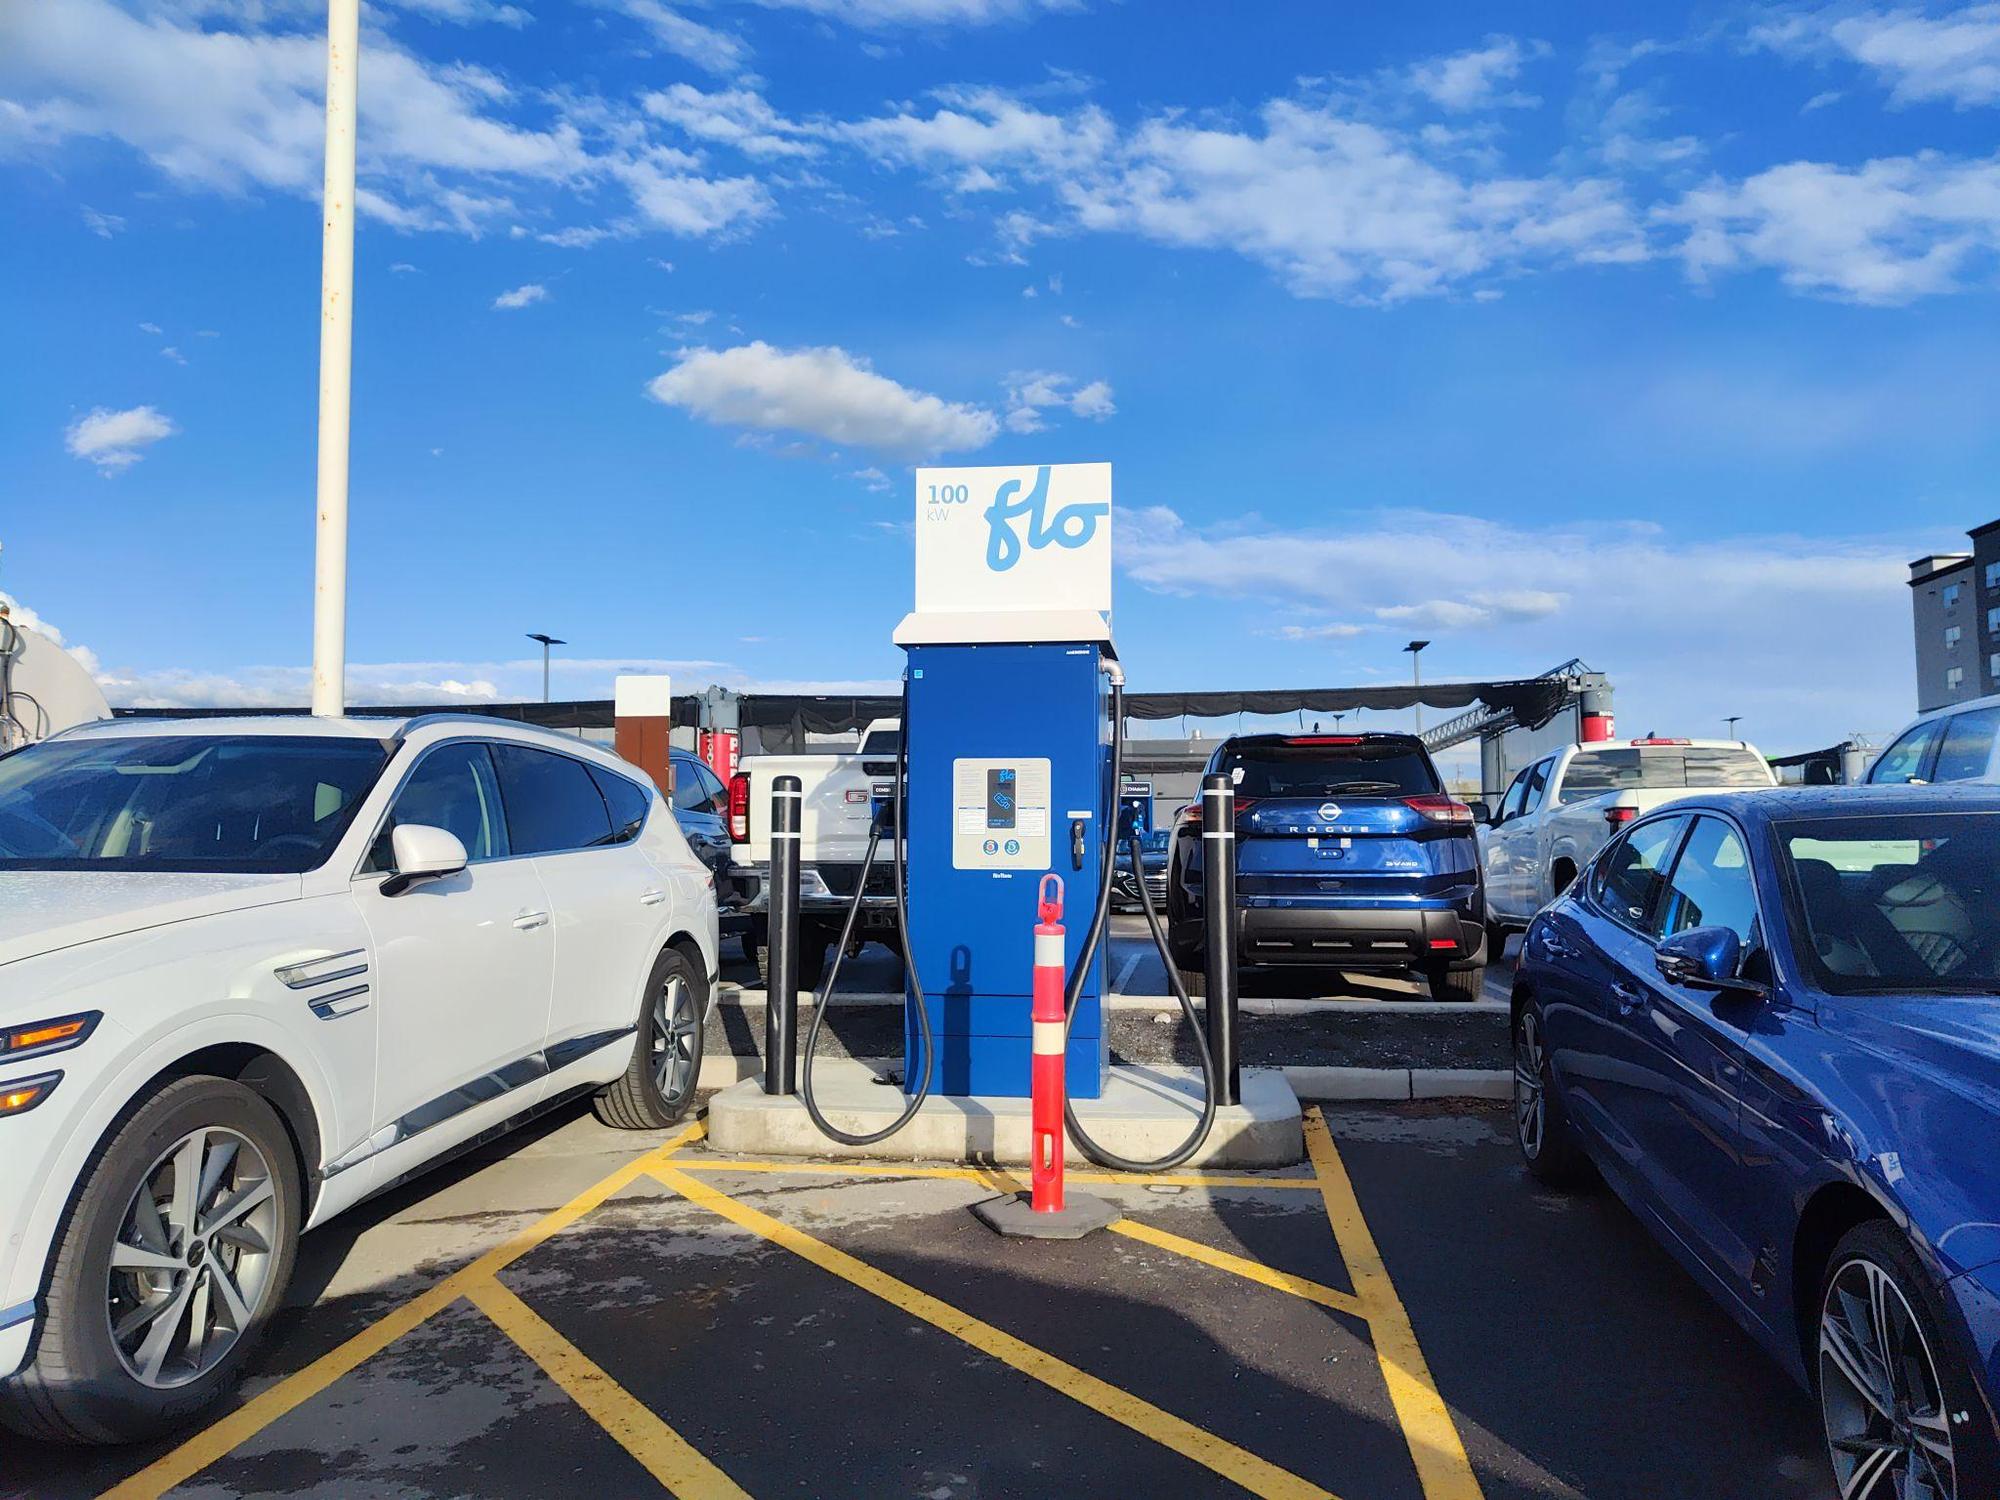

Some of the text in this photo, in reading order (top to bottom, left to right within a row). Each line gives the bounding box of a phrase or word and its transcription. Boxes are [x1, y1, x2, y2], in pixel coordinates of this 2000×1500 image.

[927, 484, 969, 504] 100
[927, 508, 950, 521] kW
[983, 466, 1110, 571] flo
